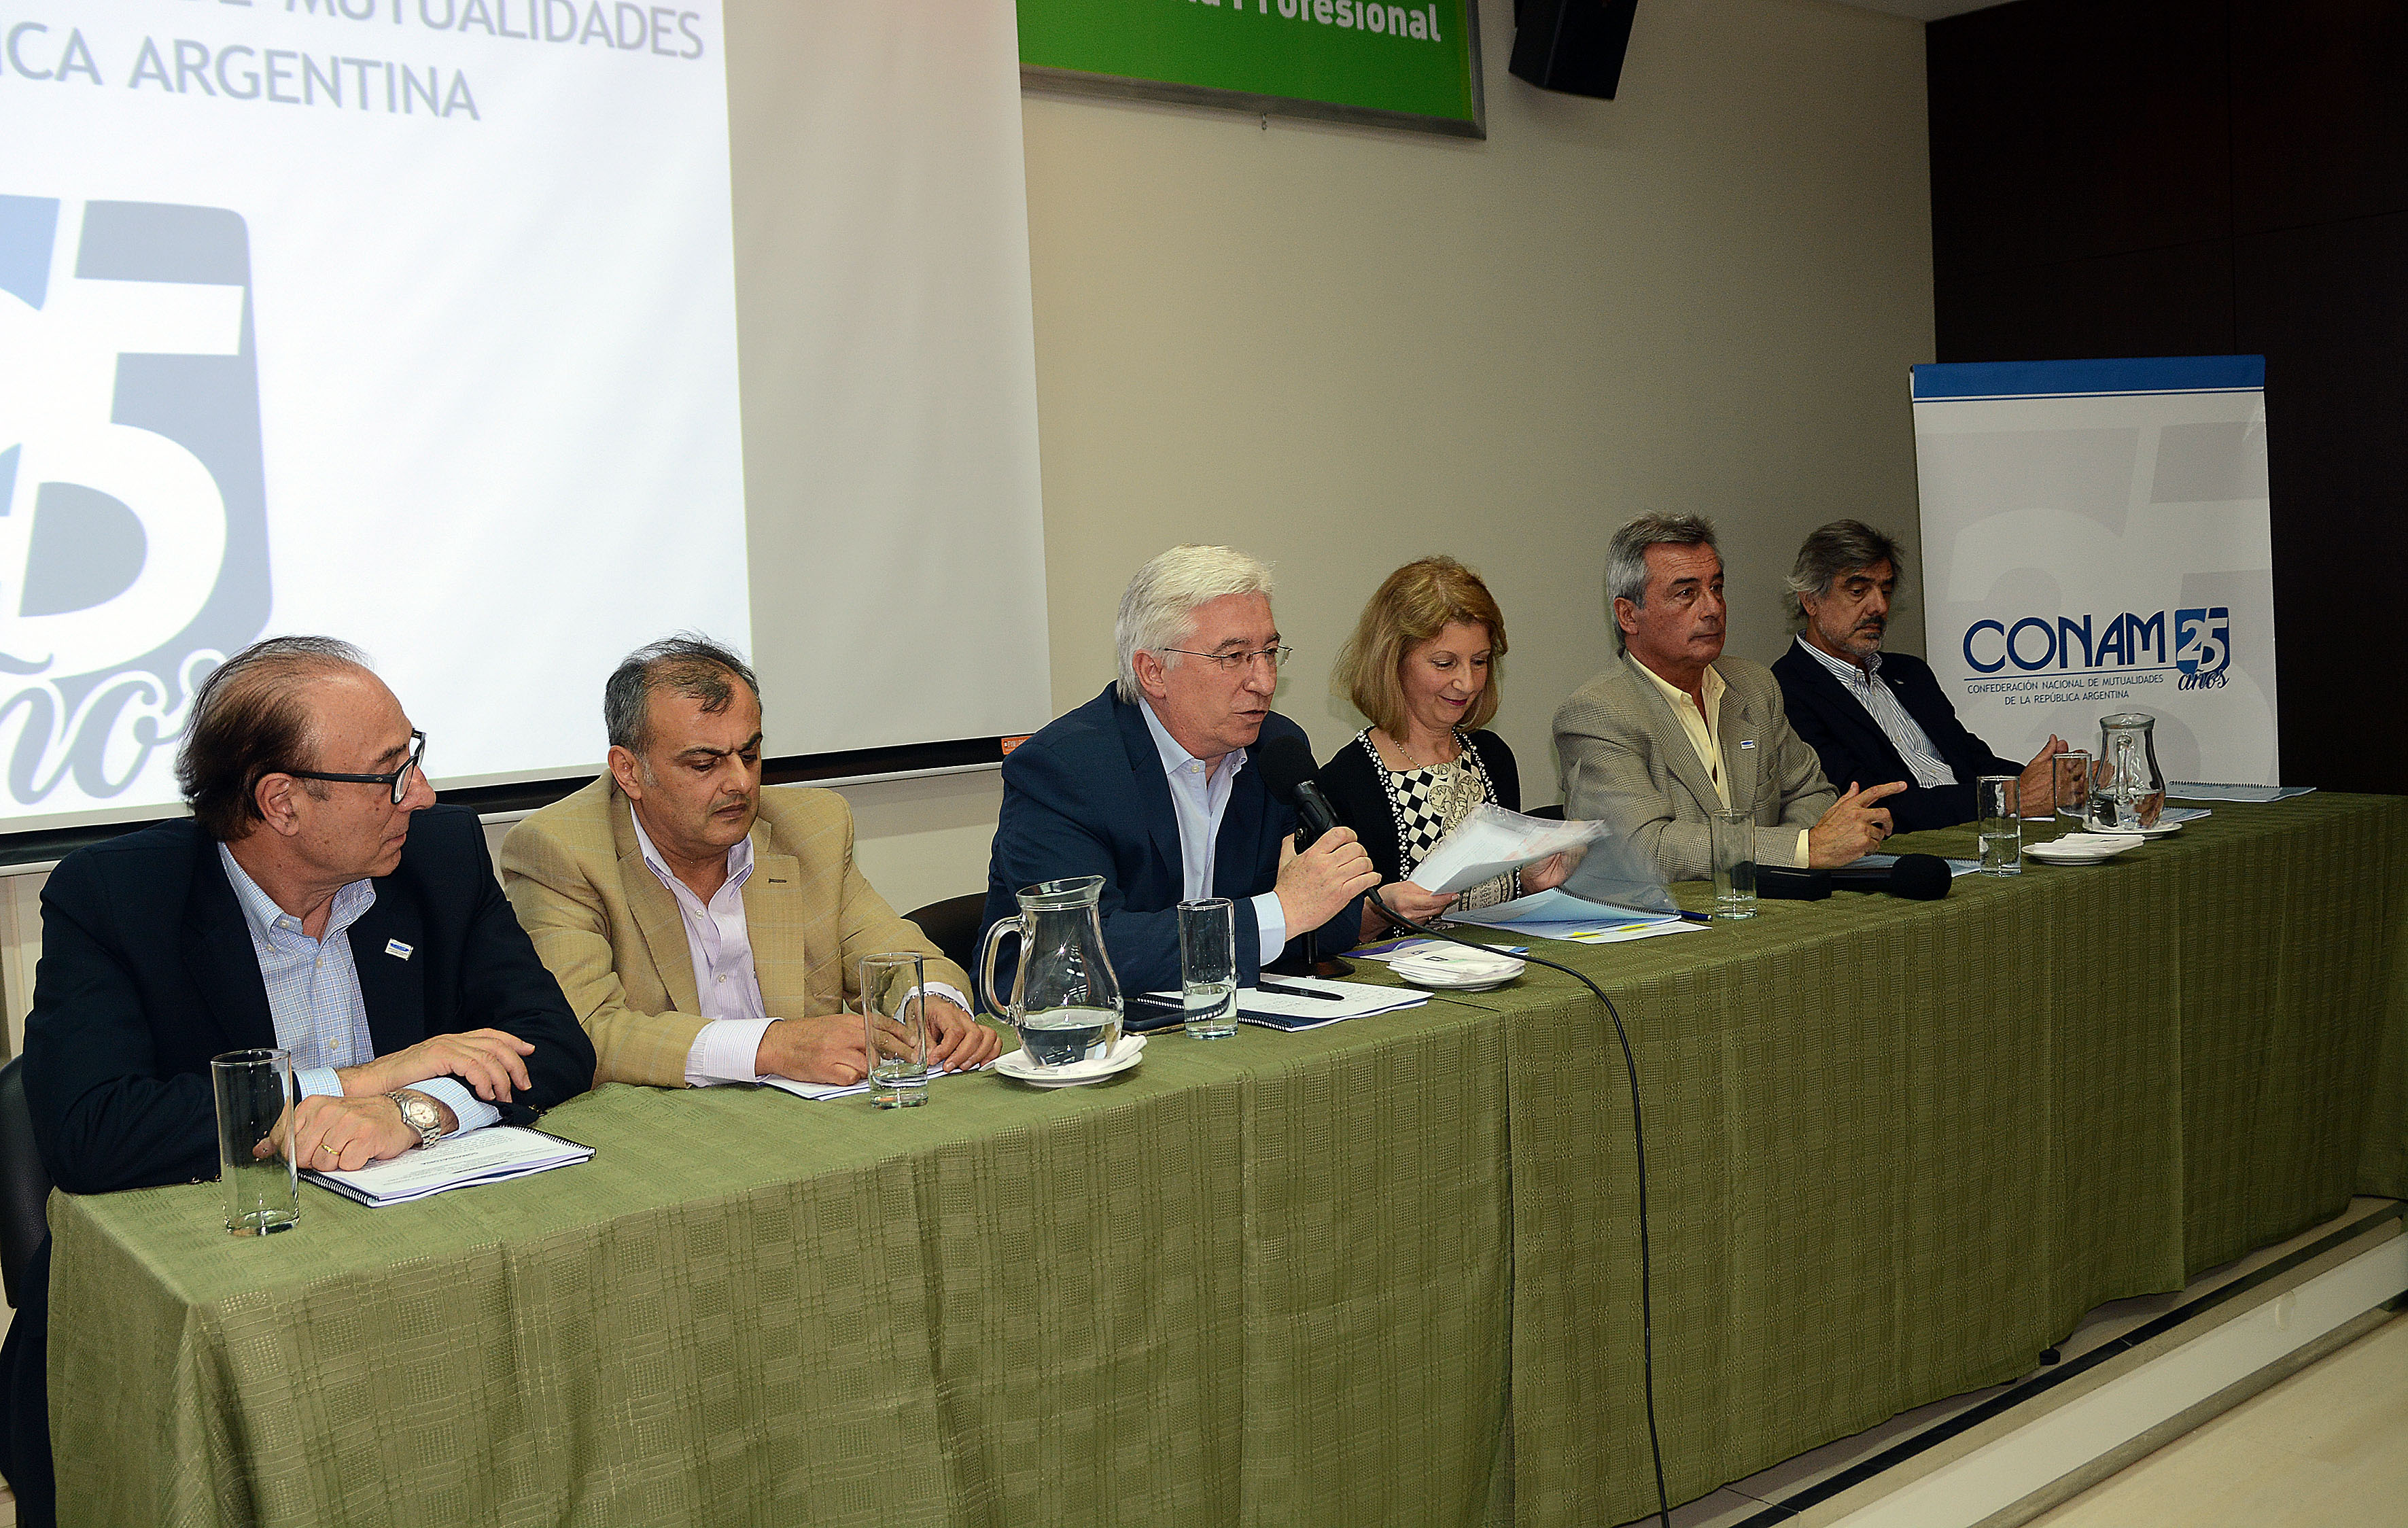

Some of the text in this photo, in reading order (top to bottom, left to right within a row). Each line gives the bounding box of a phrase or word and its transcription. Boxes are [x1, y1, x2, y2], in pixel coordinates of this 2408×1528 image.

[284, 0, 705, 60] UALIDADES
[1234, 0, 1442, 42] ofesional
[0, 21, 481, 121] CA ARGENTINA
[1963, 610, 2166, 673] CONAM
[2176, 613, 2229, 673] 25
[1967, 674, 2164, 694] CONFEDERACIÓN NACIONAL DE MUTUALIDADES
[2005, 690, 2129, 705] DE LA REPÚBLICA ARGENTINA
[2178, 669, 2230, 691] años
